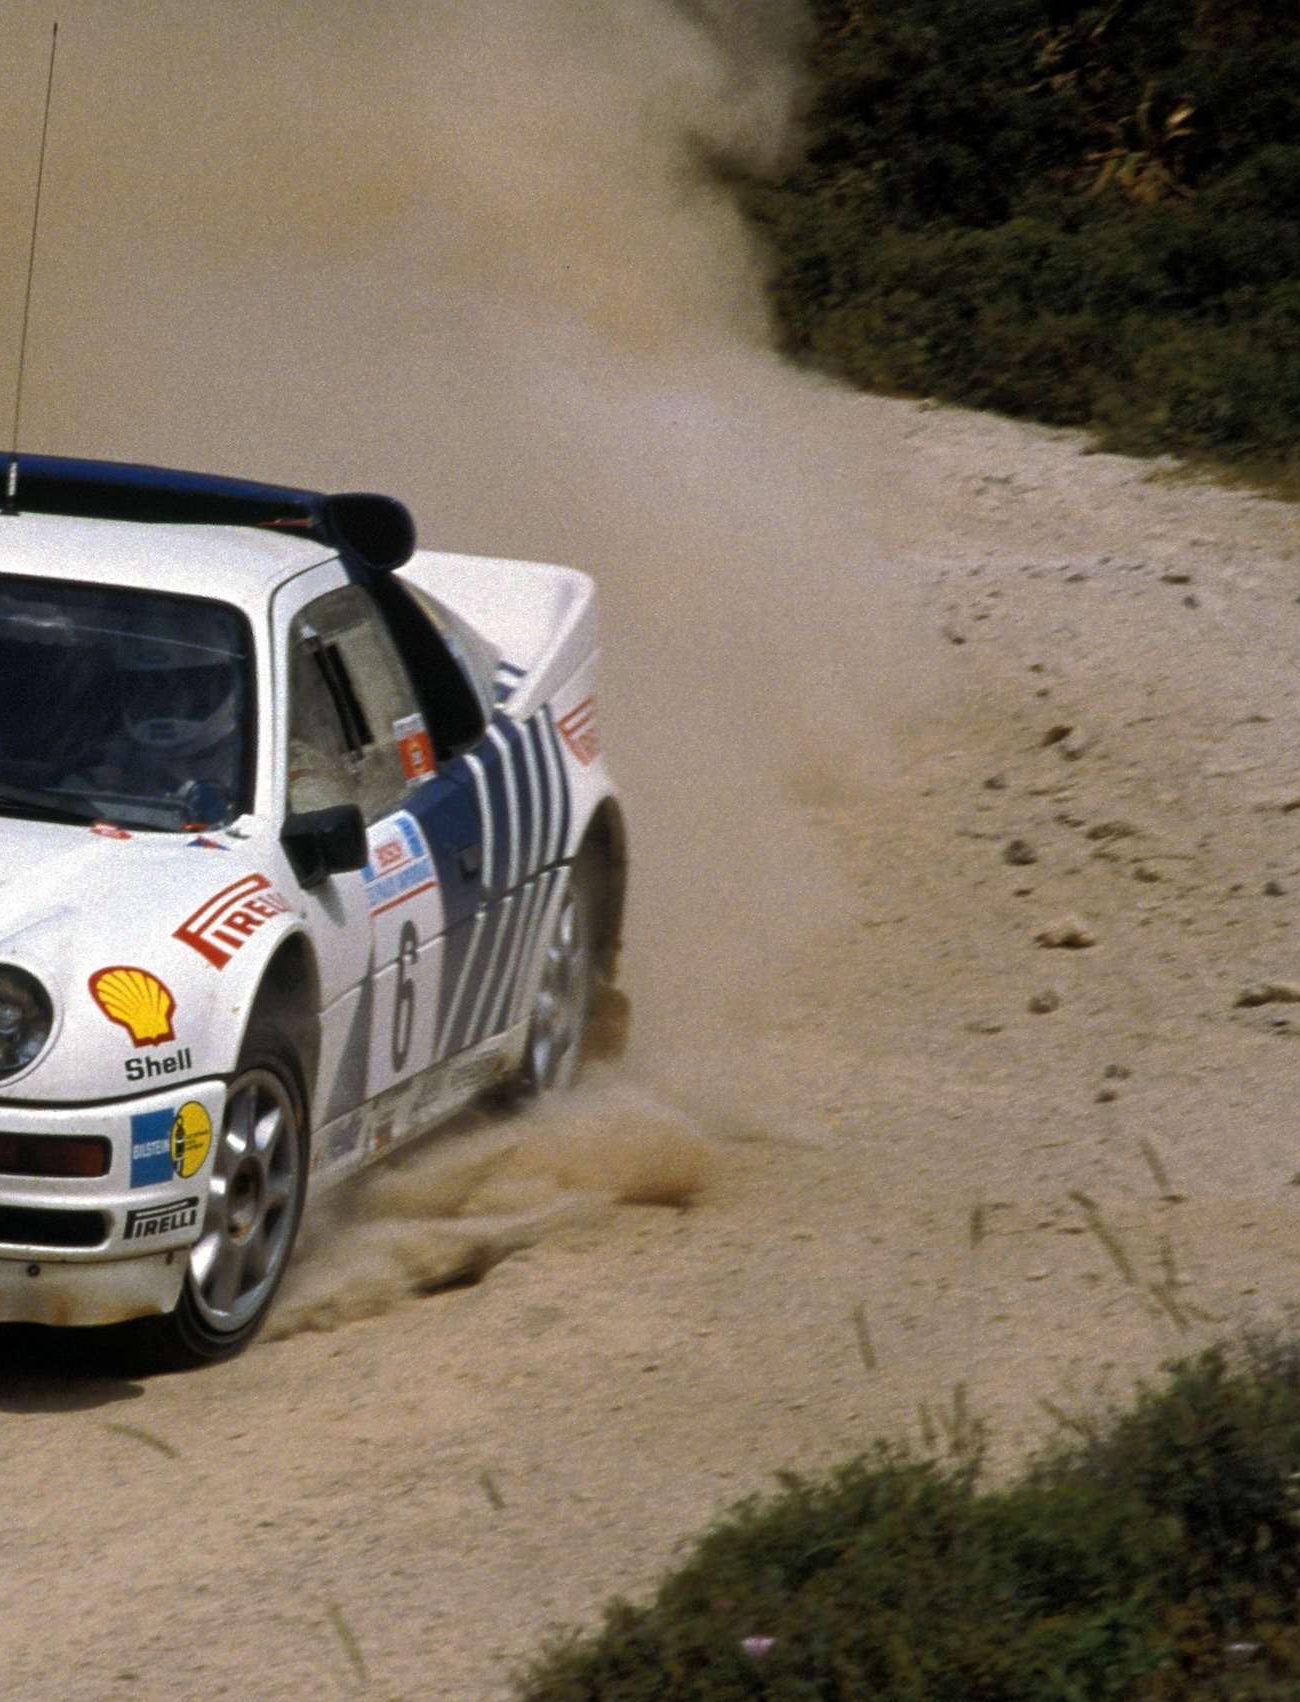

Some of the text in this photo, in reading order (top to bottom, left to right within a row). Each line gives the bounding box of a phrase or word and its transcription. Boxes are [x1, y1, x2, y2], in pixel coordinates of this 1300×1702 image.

[392, 920, 417, 1073] 6
[125, 1047, 192, 1081] Shell
[123, 1196, 199, 1239] PIRELLI
